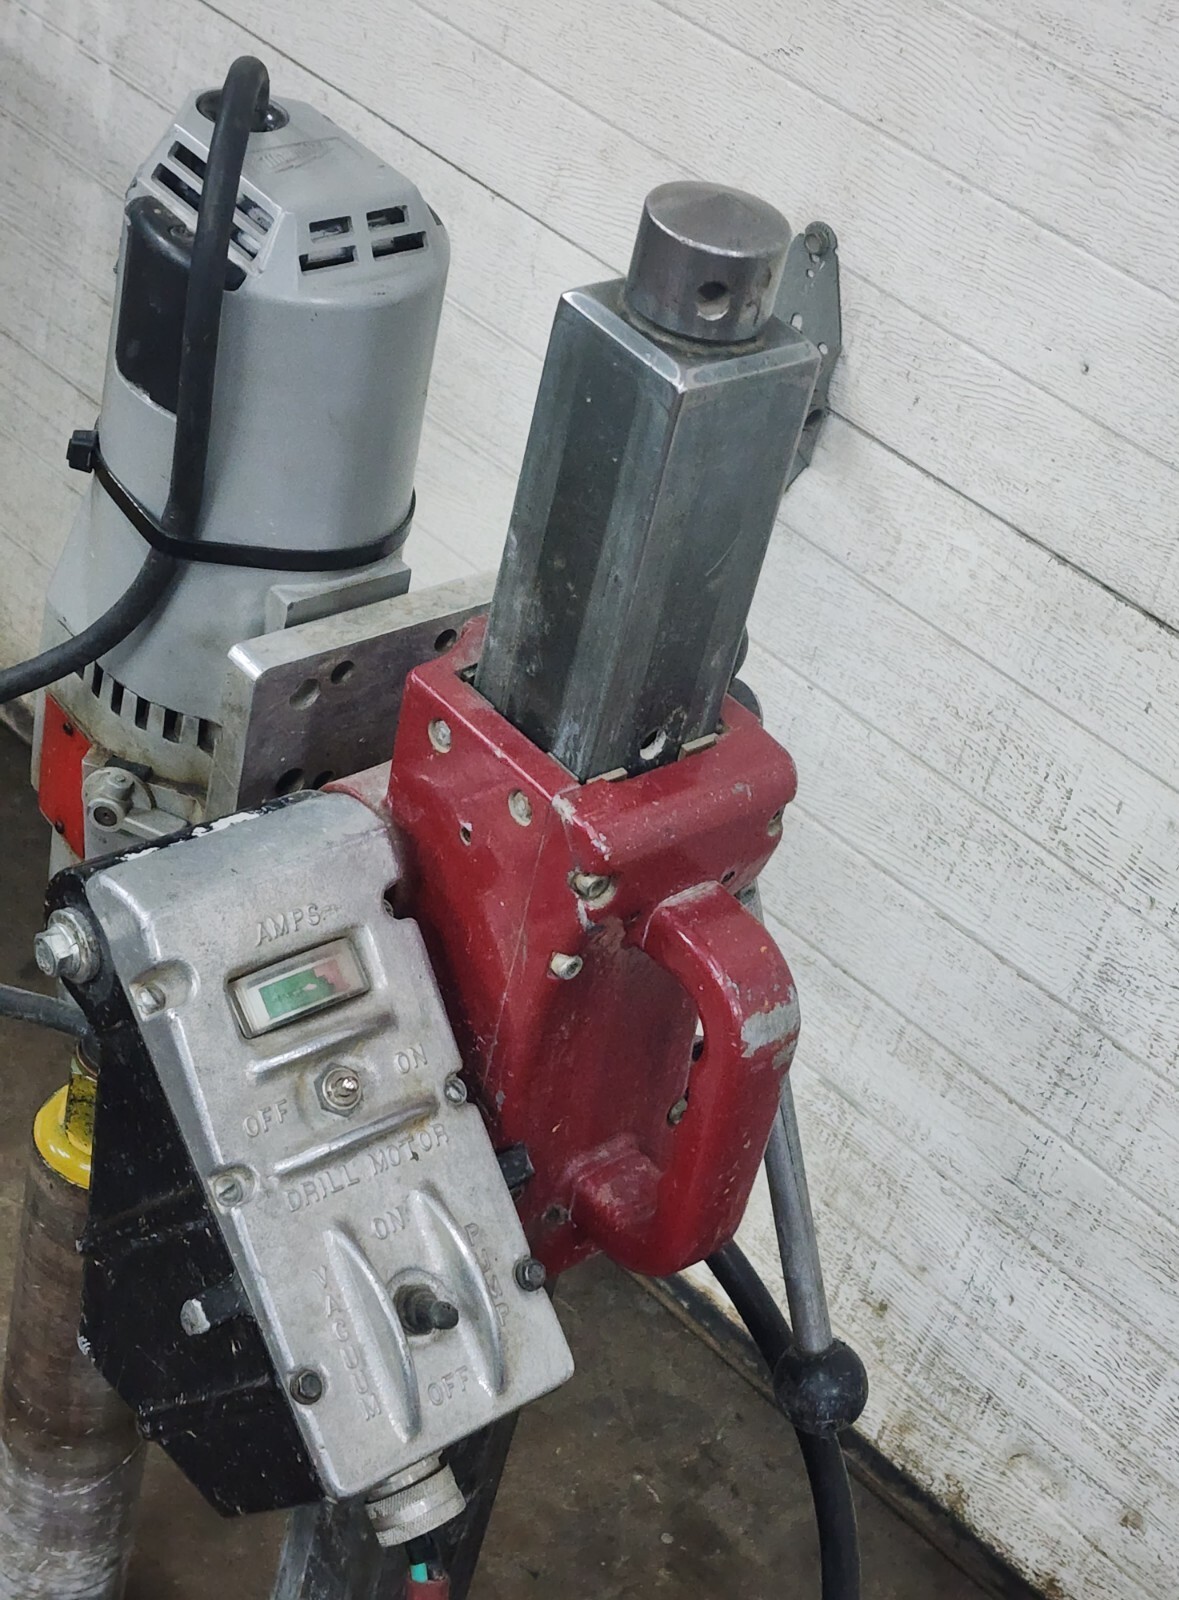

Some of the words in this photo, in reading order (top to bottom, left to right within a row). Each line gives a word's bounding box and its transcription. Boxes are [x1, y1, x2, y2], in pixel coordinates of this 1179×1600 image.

[255, 903, 321, 947] AMPS
[394, 1043, 428, 1074] ON
[242, 1099, 288, 1138] OFF
[283, 1164, 360, 1213] DRILL
[368, 1123, 449, 1177] MOTOR
[371, 1205, 407, 1241] ON
[312, 1264, 382, 1422] VACUUM
[427, 1365, 471, 1406] OFF
